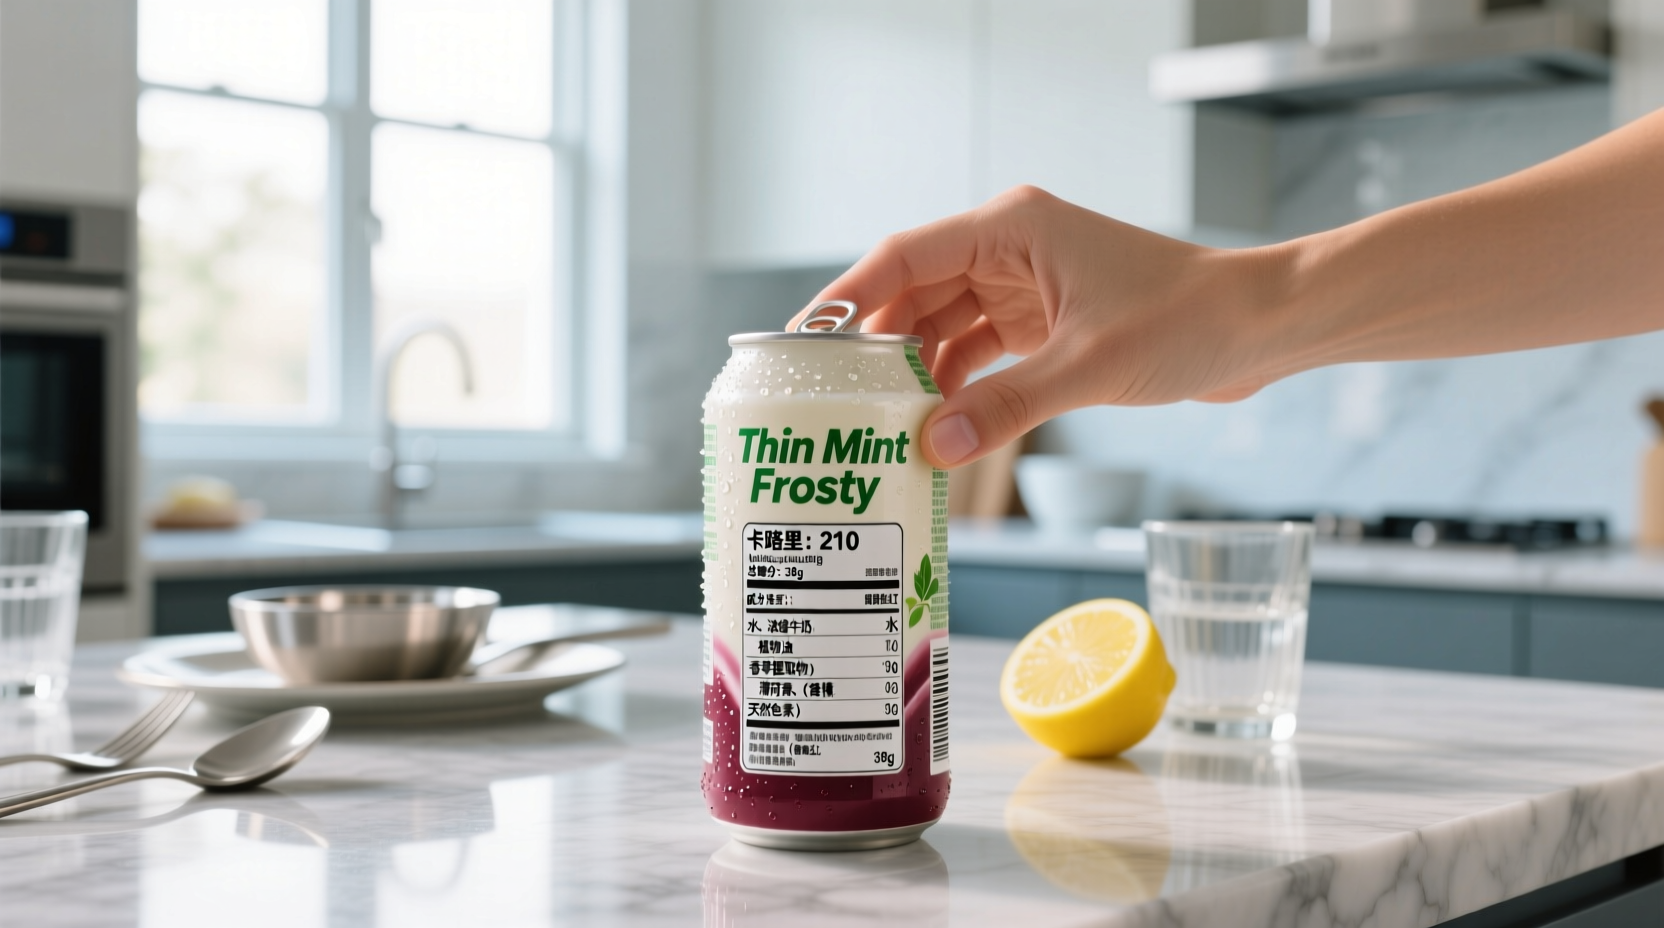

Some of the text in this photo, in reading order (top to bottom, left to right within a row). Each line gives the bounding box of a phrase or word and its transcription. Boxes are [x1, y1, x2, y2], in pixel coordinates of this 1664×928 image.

[738, 427, 910, 464] Thin Mint
[750, 468, 881, 515] Frosty
[819, 530, 860, 551] 210
[885, 616, 899, 633] 水
